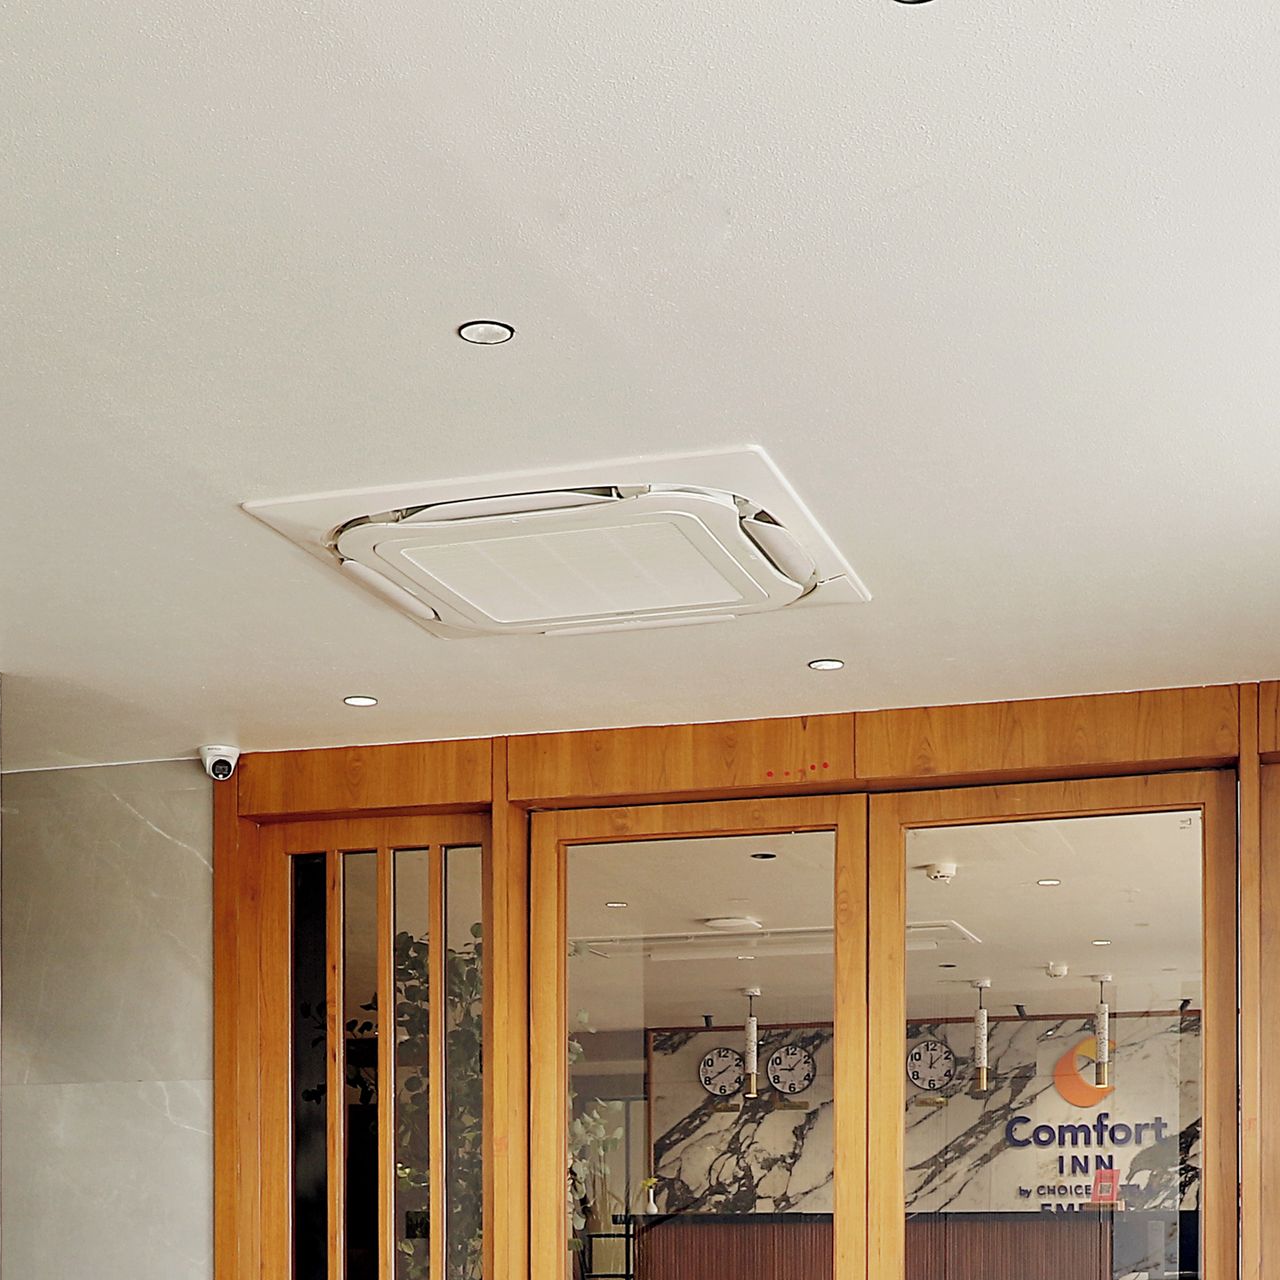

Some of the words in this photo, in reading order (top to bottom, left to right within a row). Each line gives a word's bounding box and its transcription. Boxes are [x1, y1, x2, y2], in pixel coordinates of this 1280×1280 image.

[924, 1042, 937, 1051] 12
[717, 1049, 729, 1058] 12
[785, 1047, 797, 1056] 12
[771, 1056, 781, 1065] 10
[910, 1052, 921, 1061] 10
[703, 1058, 714, 1067] 10
[1005, 1113, 1168, 1148] Comfort
[1058, 1154, 1113, 1175] INN
[1018, 1186, 1032, 1198] by
[1036, 1184, 1092, 1196] CHOICE
